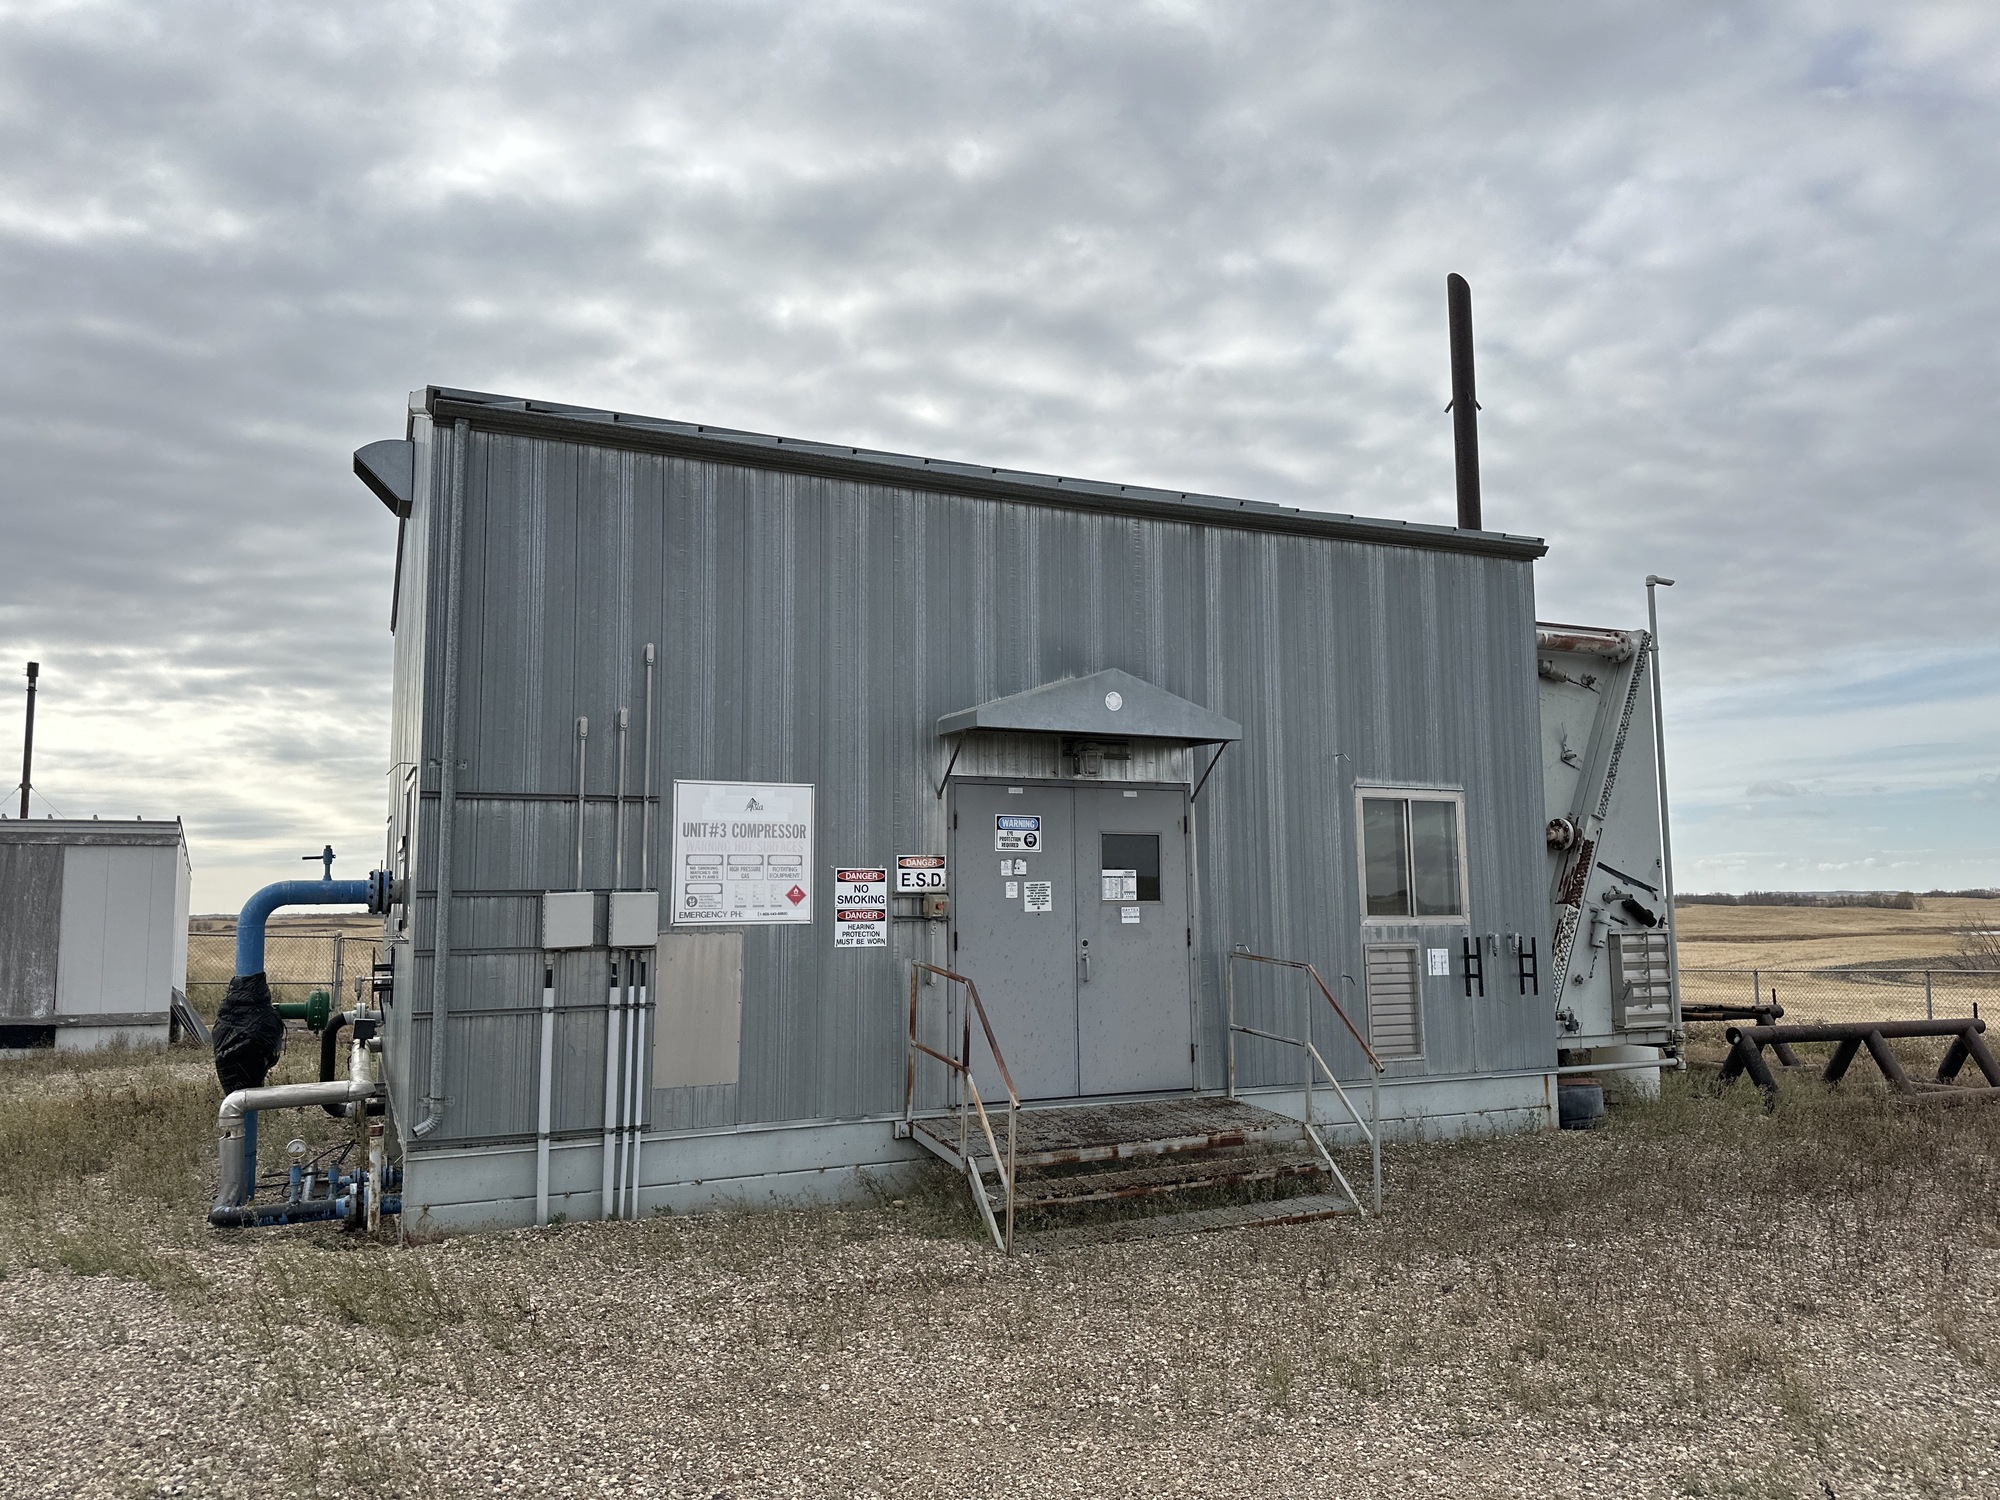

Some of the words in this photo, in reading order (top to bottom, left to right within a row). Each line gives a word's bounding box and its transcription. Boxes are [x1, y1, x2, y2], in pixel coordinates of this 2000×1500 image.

[1002, 819, 1035, 828] WARNING
[682, 822, 727, 838] UNIT#3
[731, 823, 807, 839] COMPRESSOR
[686, 840, 731, 852] WARNING
[734, 841, 753, 852] HOT
[759, 841, 804, 853] SURFACES
[845, 872, 878, 880] DANGER
[901, 872, 945, 887] E.S.D.
[853, 884, 869, 893] NO
[837, 895, 885, 904] SMOKING
[678, 911, 728, 919] EMERGENCY
[845, 911, 878, 919] DANGER
[847, 923, 875, 931] HEARING
